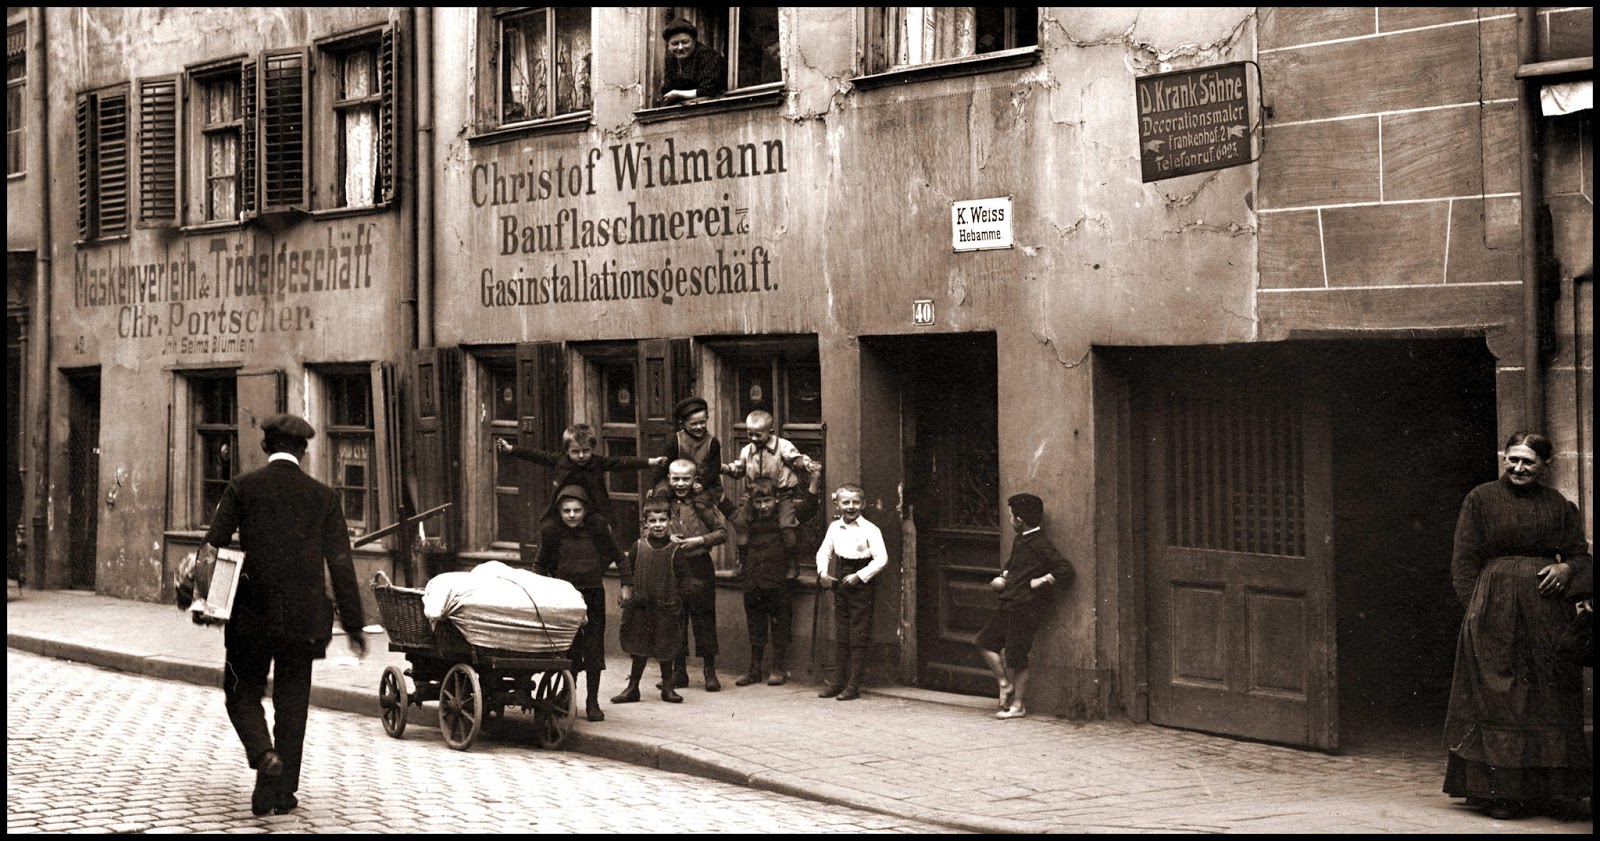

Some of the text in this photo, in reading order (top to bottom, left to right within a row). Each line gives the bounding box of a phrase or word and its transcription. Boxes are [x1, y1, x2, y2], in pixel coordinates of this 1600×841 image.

[1200, 72, 1243, 106] Söhne
[1142, 104, 1244, 137] Decorationsmaler
[471, 137, 788, 207] Christof Widmann
[500, 193, 734, 256] Bauflaschnerei
[956, 206, 1005, 225] K. Weiss
[959, 229, 1002, 242] Hebamme
[73, 223, 373, 308] Maskenverleih & Trödelgeschäft
[480, 245, 780, 305] Gasinstallationsgeschäft.
[117, 298, 315, 339] Chr. Portscher.
[914, 303, 932, 323] 40
[180, 336, 209, 355] Selma
